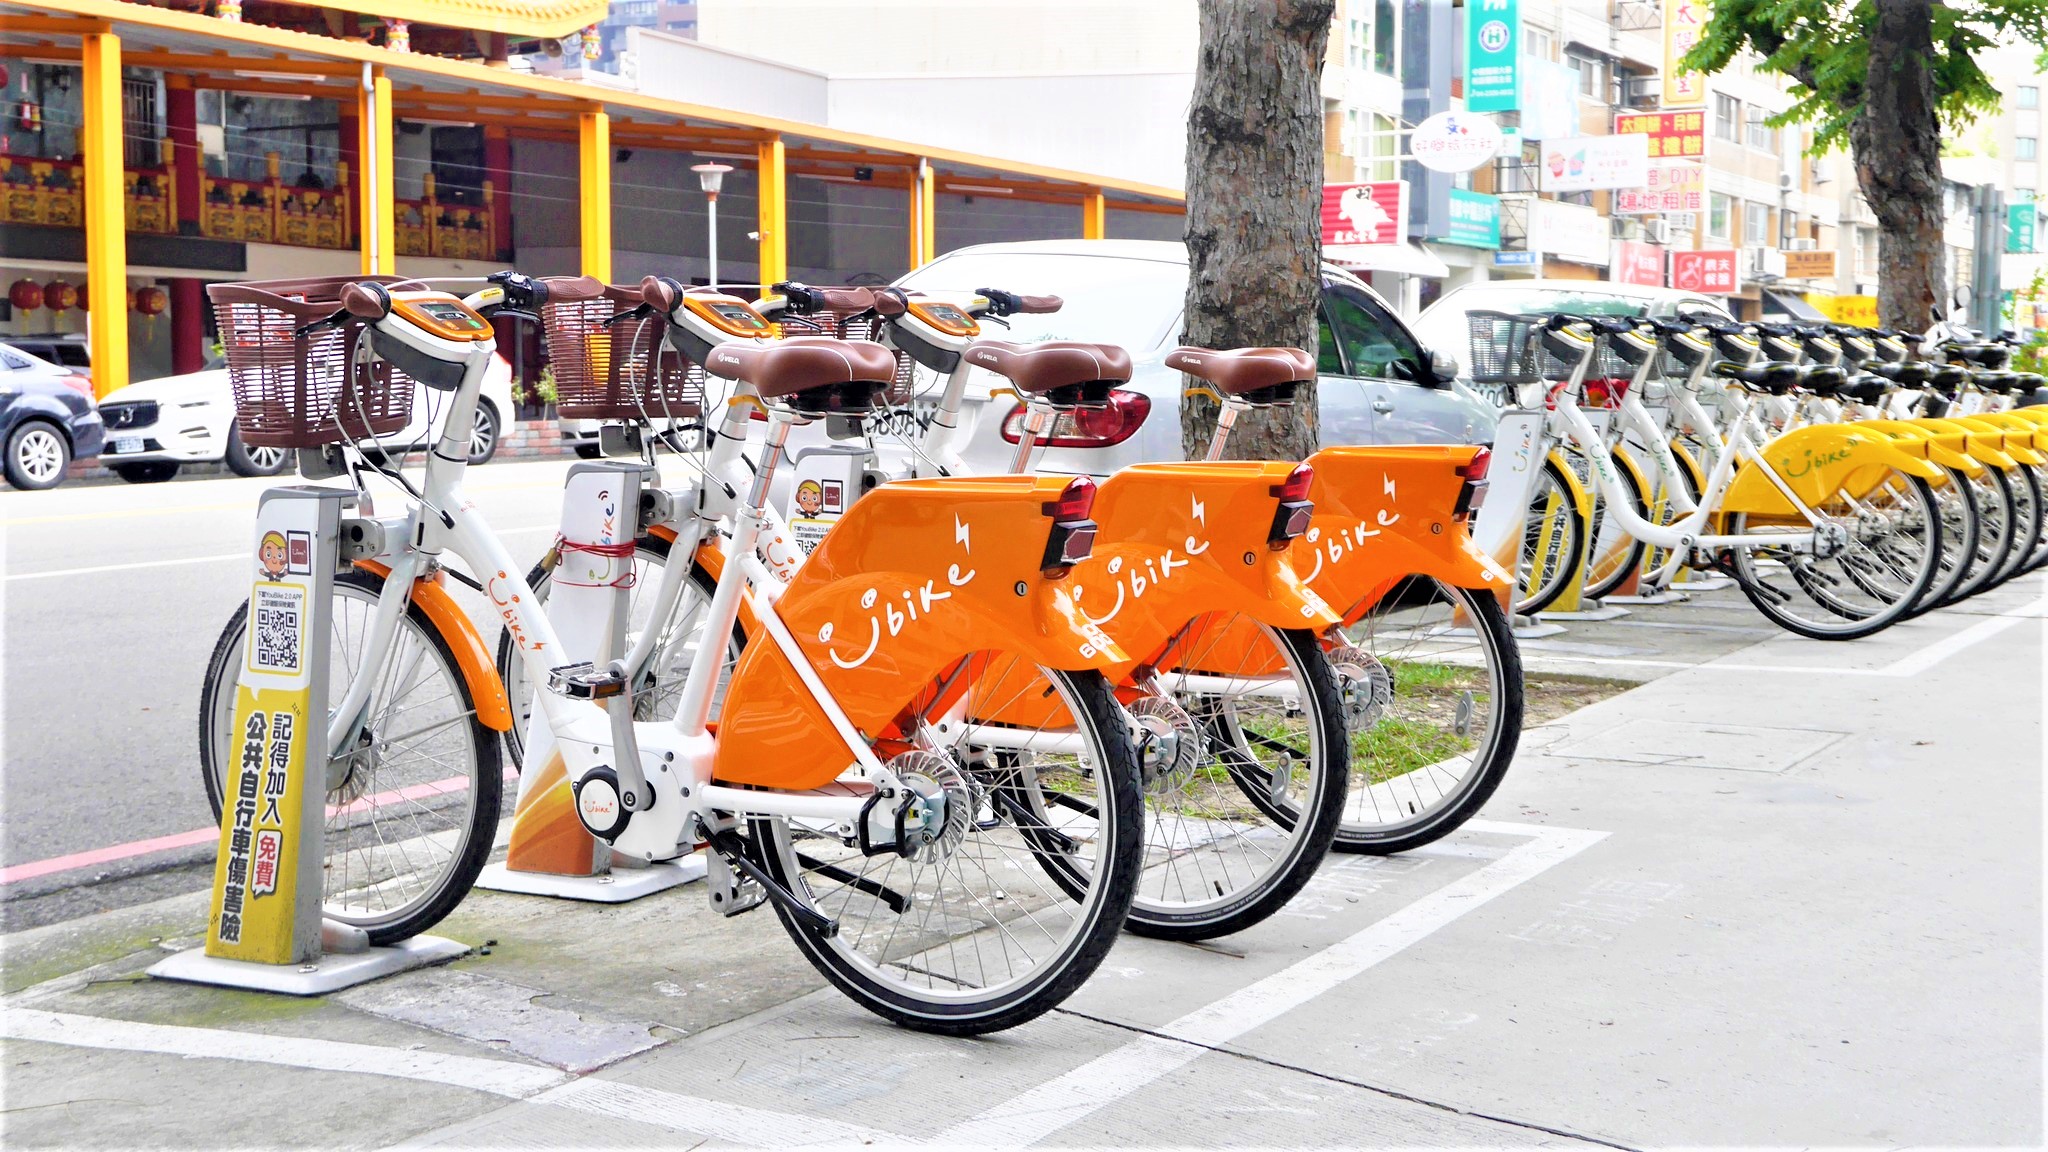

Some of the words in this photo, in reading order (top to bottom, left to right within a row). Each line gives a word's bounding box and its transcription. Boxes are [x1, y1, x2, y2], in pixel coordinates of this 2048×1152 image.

[1670, 167, 1702, 184] DIY
[724, 355, 740, 365] VELO
[261, 714, 293, 824] 記得加入
[220, 713, 267, 942] 公共自行車傷害險
[255, 835, 276, 887] 免費
